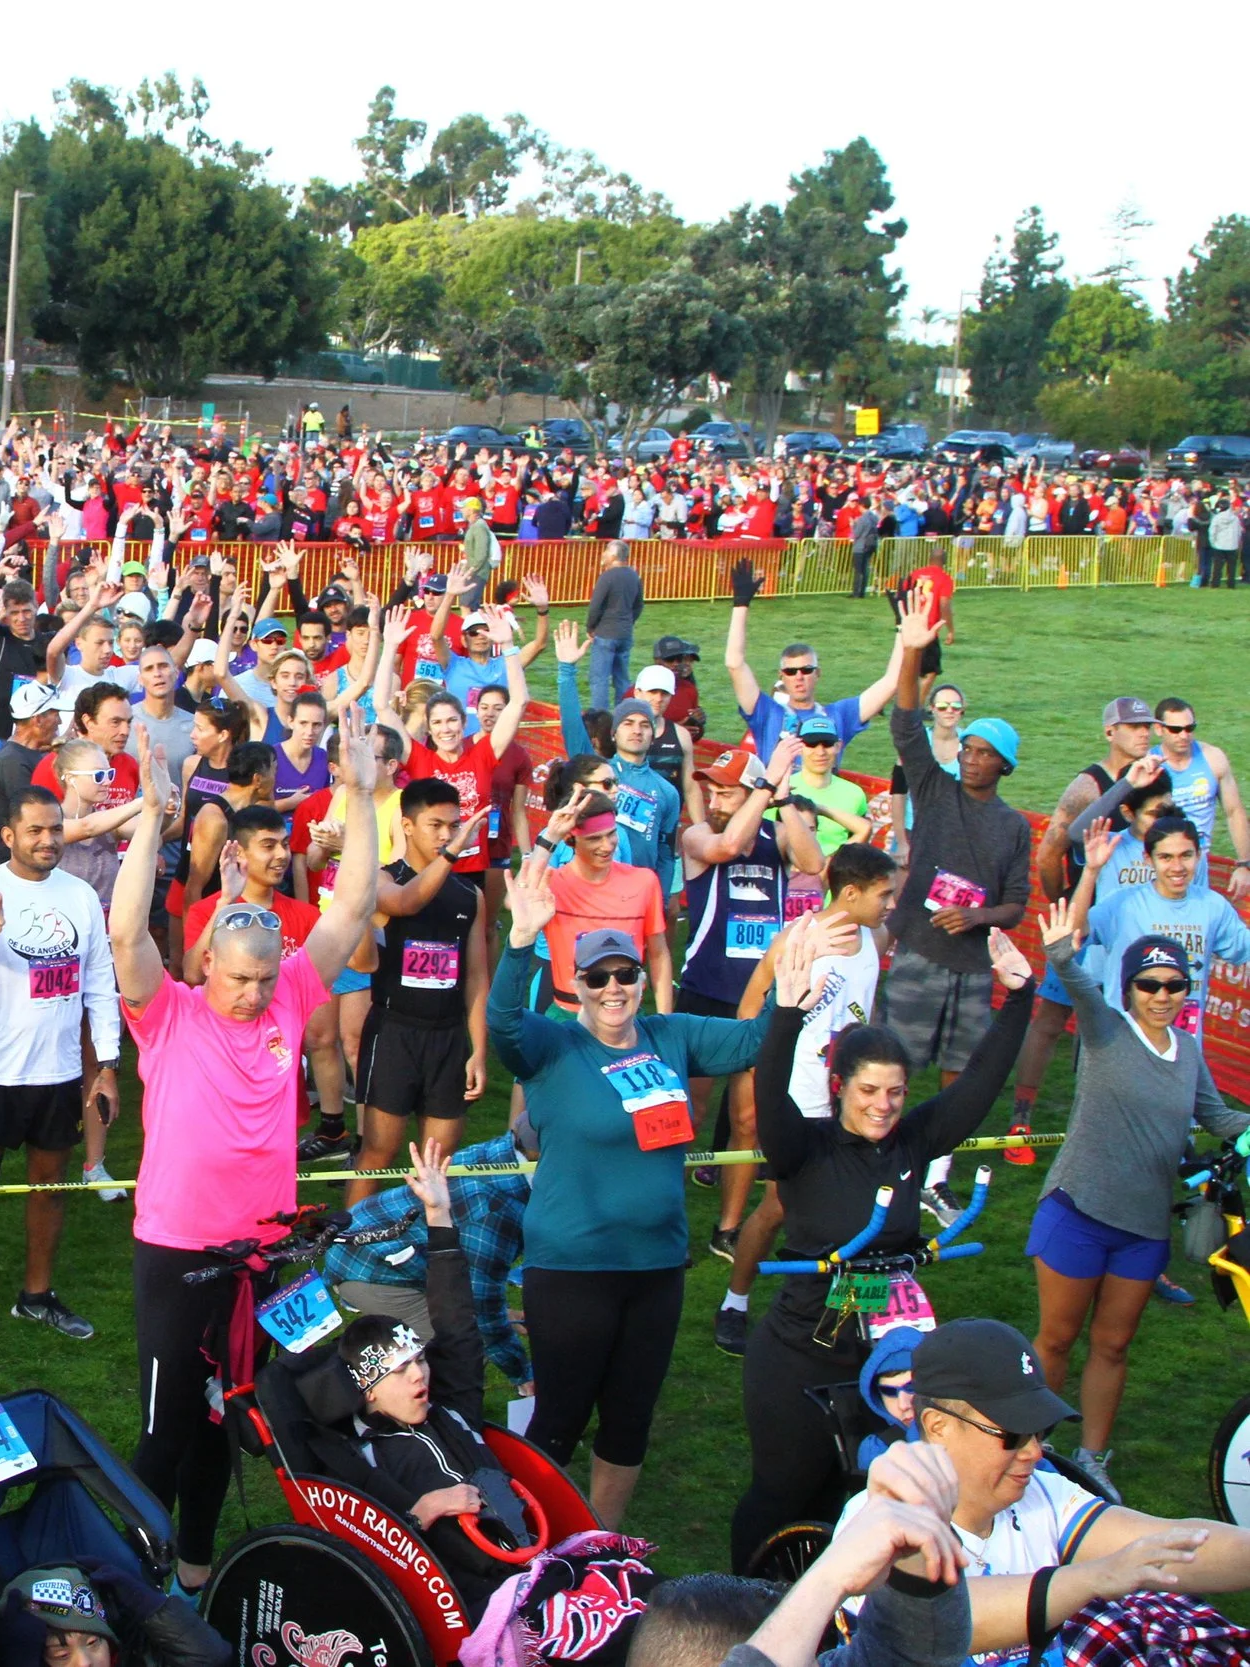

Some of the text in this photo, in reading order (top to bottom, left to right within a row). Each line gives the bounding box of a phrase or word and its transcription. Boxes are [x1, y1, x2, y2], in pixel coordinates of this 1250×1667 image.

[419, 663, 437, 677] 563
[8, 938, 18, 949] DE
[19, 944, 36, 955] LOS
[36, 937, 71, 955] ANGELES
[735, 923, 765, 945] 809
[407, 951, 449, 975] 2292
[33, 966, 73, 994] 2042
[621, 1063, 665, 1092] 118
[270, 1293, 316, 1336] 542
[334, 1513, 409, 1570] RUN EVERYTHING LABS
[307, 1486, 464, 1630] HOYT RACING.COM
[34, 1581, 71, 1590] TOURING
